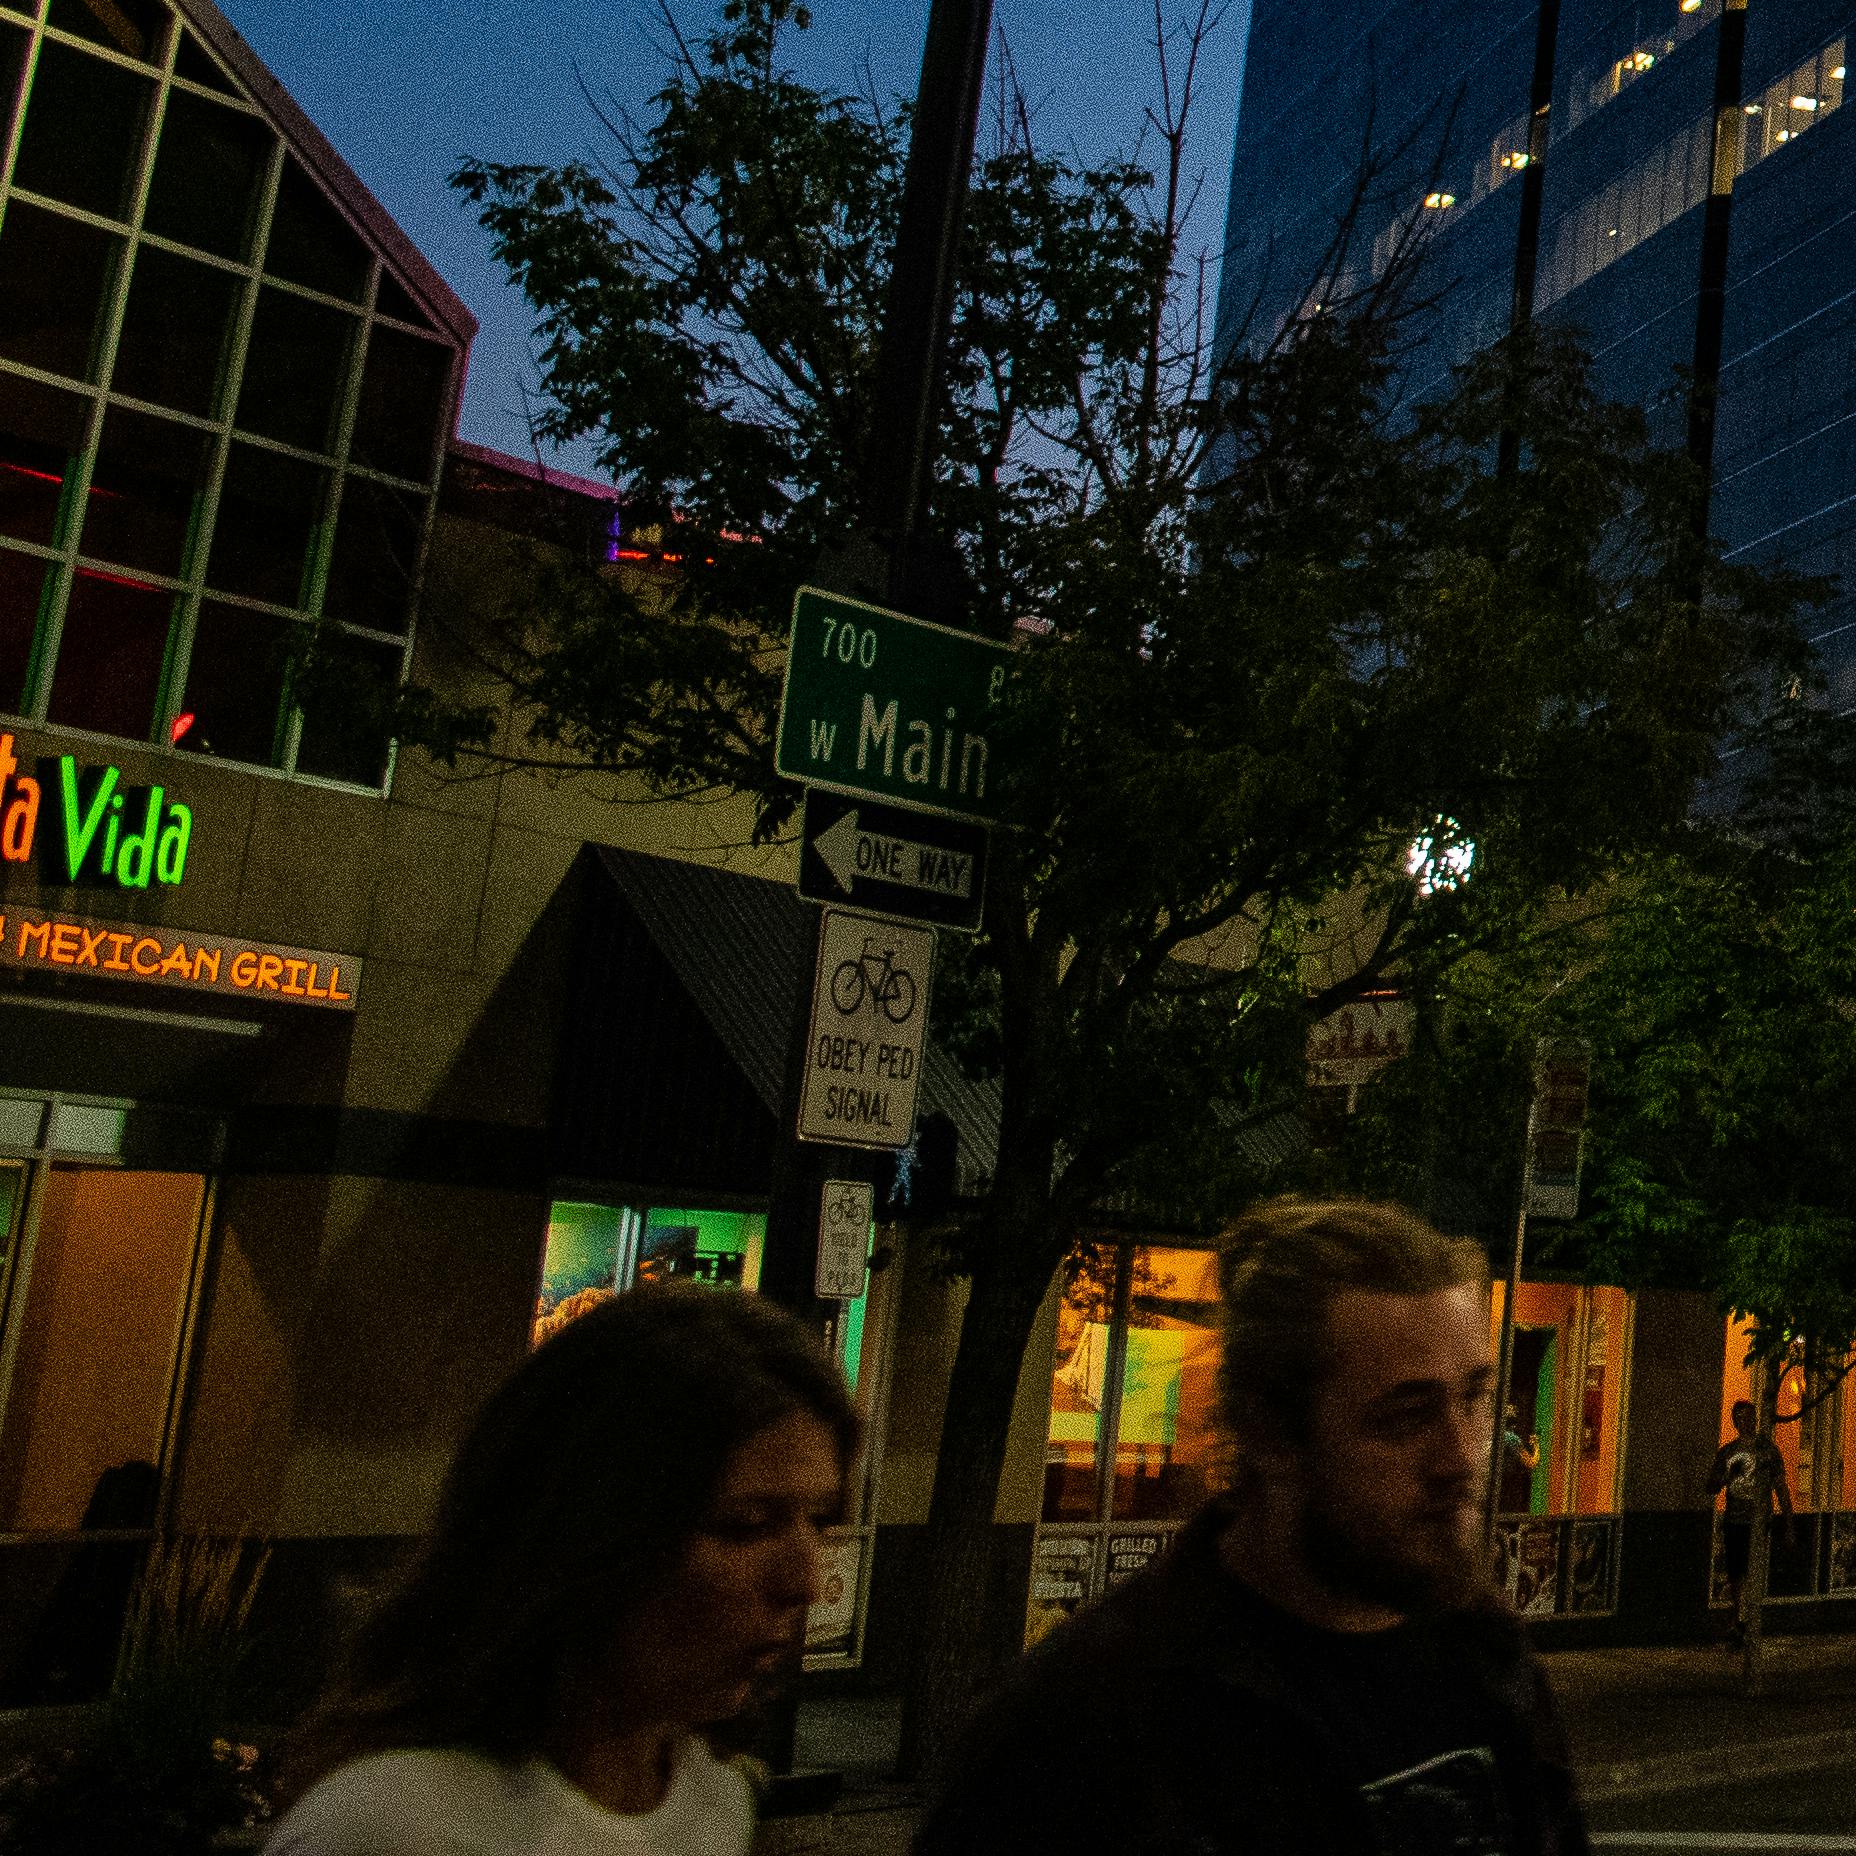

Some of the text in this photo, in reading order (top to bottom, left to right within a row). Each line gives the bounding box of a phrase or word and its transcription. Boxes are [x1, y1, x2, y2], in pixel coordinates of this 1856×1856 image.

[822, 616, 878, 669] 700
[856, 692, 989, 799] Main
[60, 754, 193, 889] Vida
[855, 836, 969, 892] ONE WAY
[18, 921, 222, 982] MEXICAN
[230, 951, 351, 1002] GRILL
[817, 1034, 915, 1081] OBEY PED
[824, 1085, 893, 1129] SIGNAL
[1110, 1538, 1157, 1555] GRILLED
